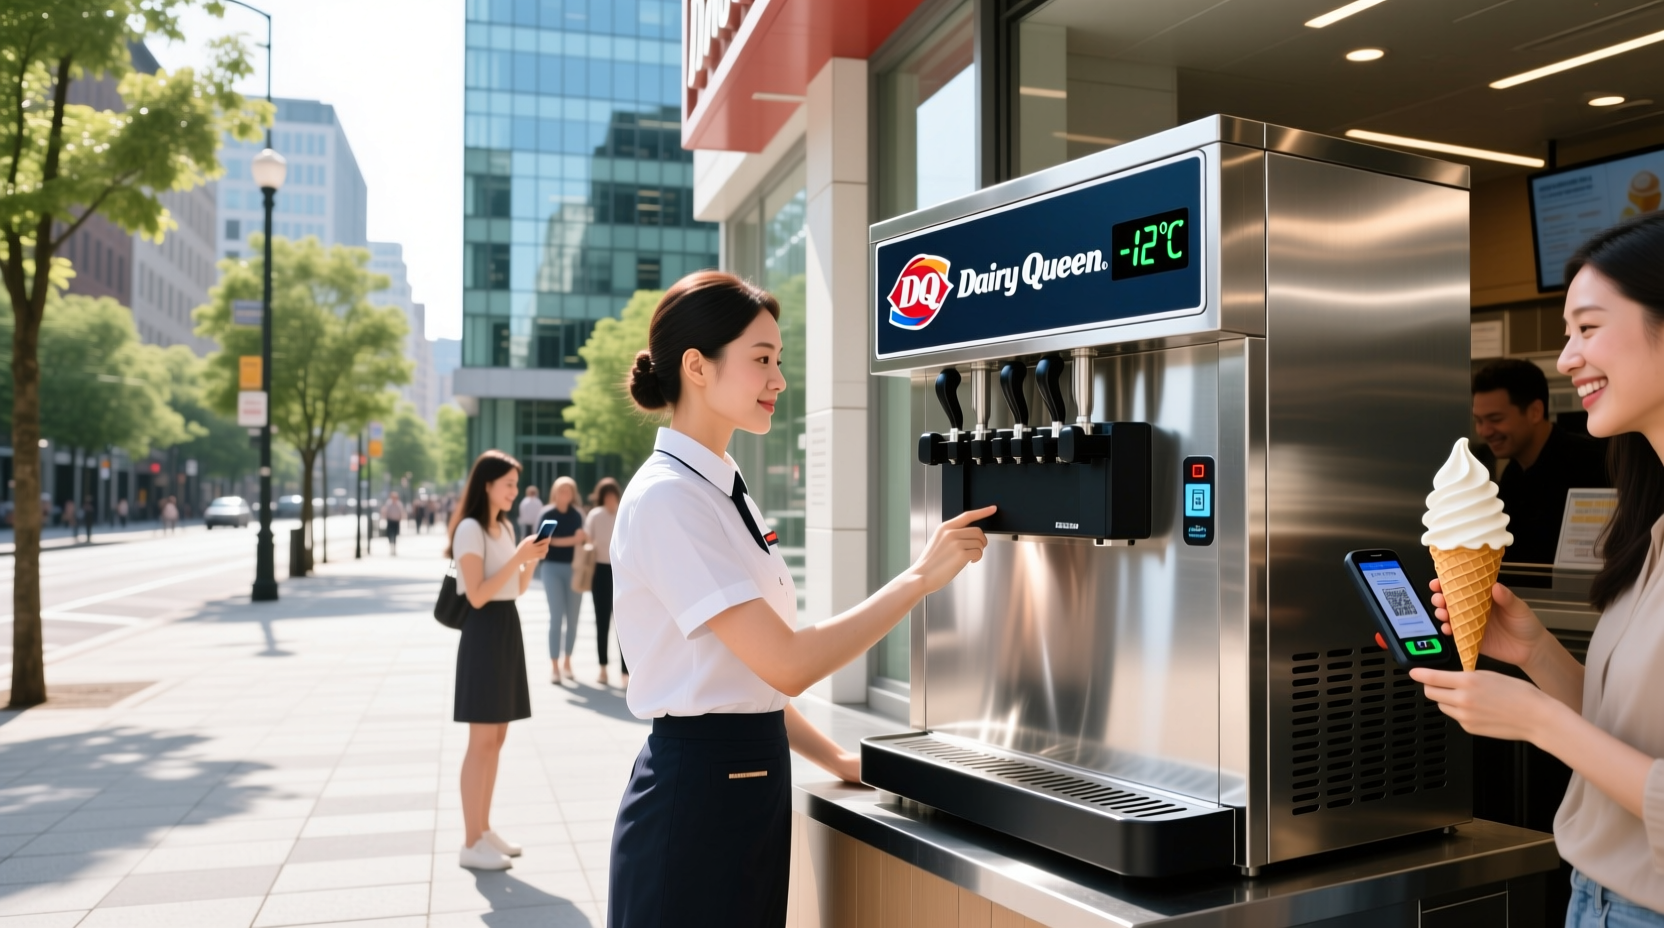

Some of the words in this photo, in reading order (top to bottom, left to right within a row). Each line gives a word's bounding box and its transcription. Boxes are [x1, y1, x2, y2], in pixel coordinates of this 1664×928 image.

[1120, 219, 1184, 267] -12°C
[899, 272, 940, 310] DQ
[957, 263, 1019, 297] Dairy
